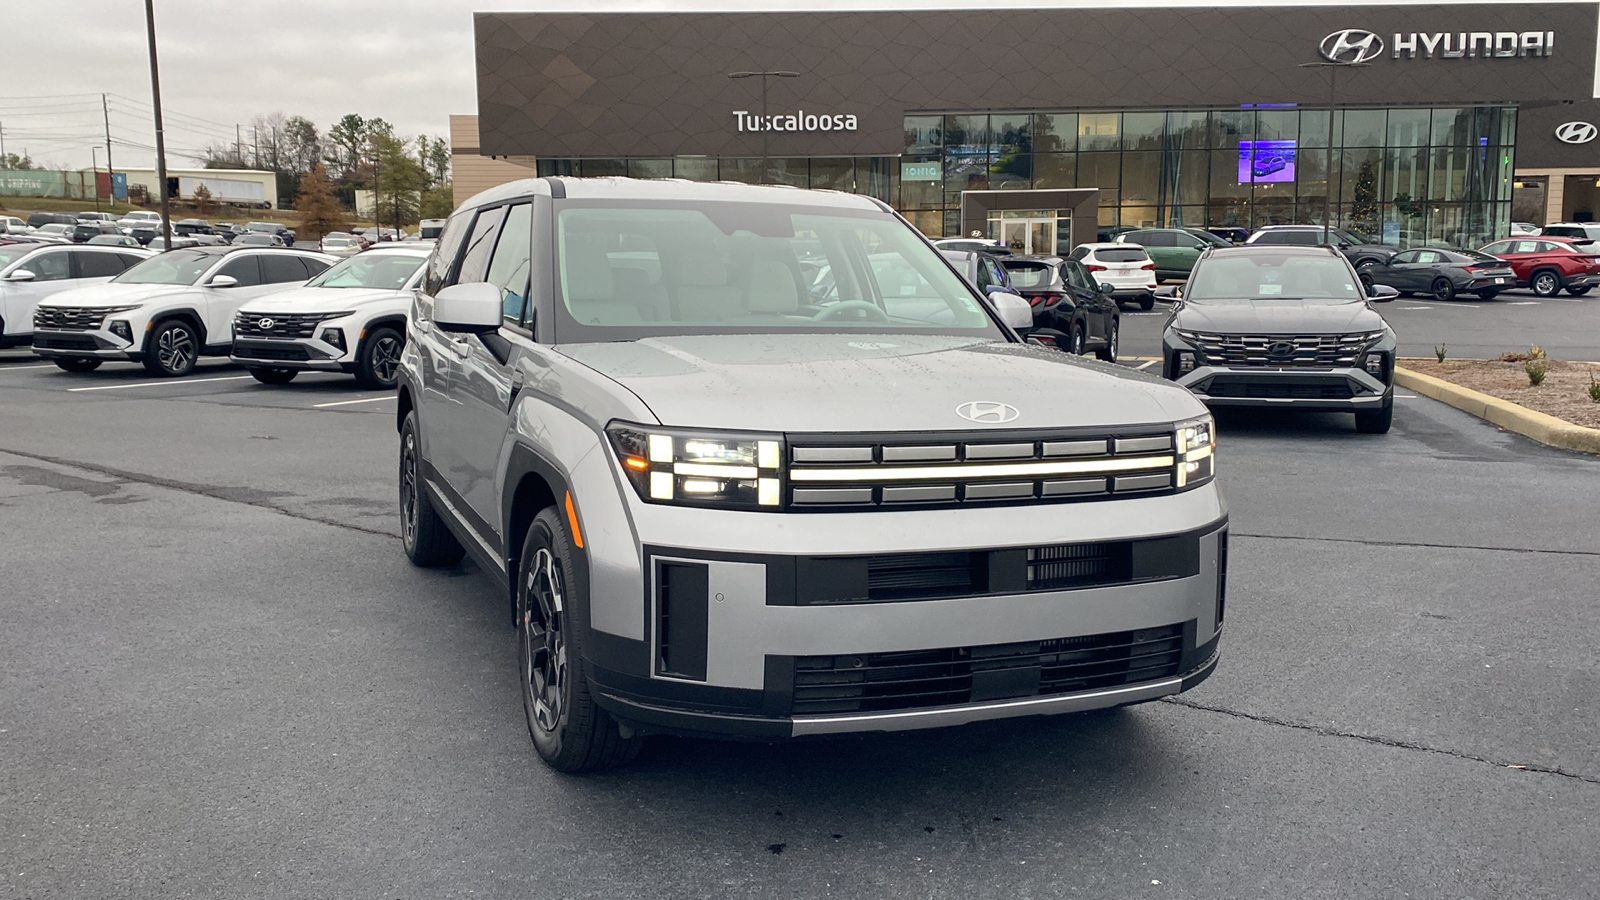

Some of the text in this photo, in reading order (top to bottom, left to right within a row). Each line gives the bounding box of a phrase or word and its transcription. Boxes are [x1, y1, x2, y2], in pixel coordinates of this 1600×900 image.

[1393, 31, 1555, 59] HYUNDAI
[732, 109, 858, 131] Tuscaloosa
[905, 167, 937, 176] IONIQ
[7, 178, 41, 189] SHIPPING
